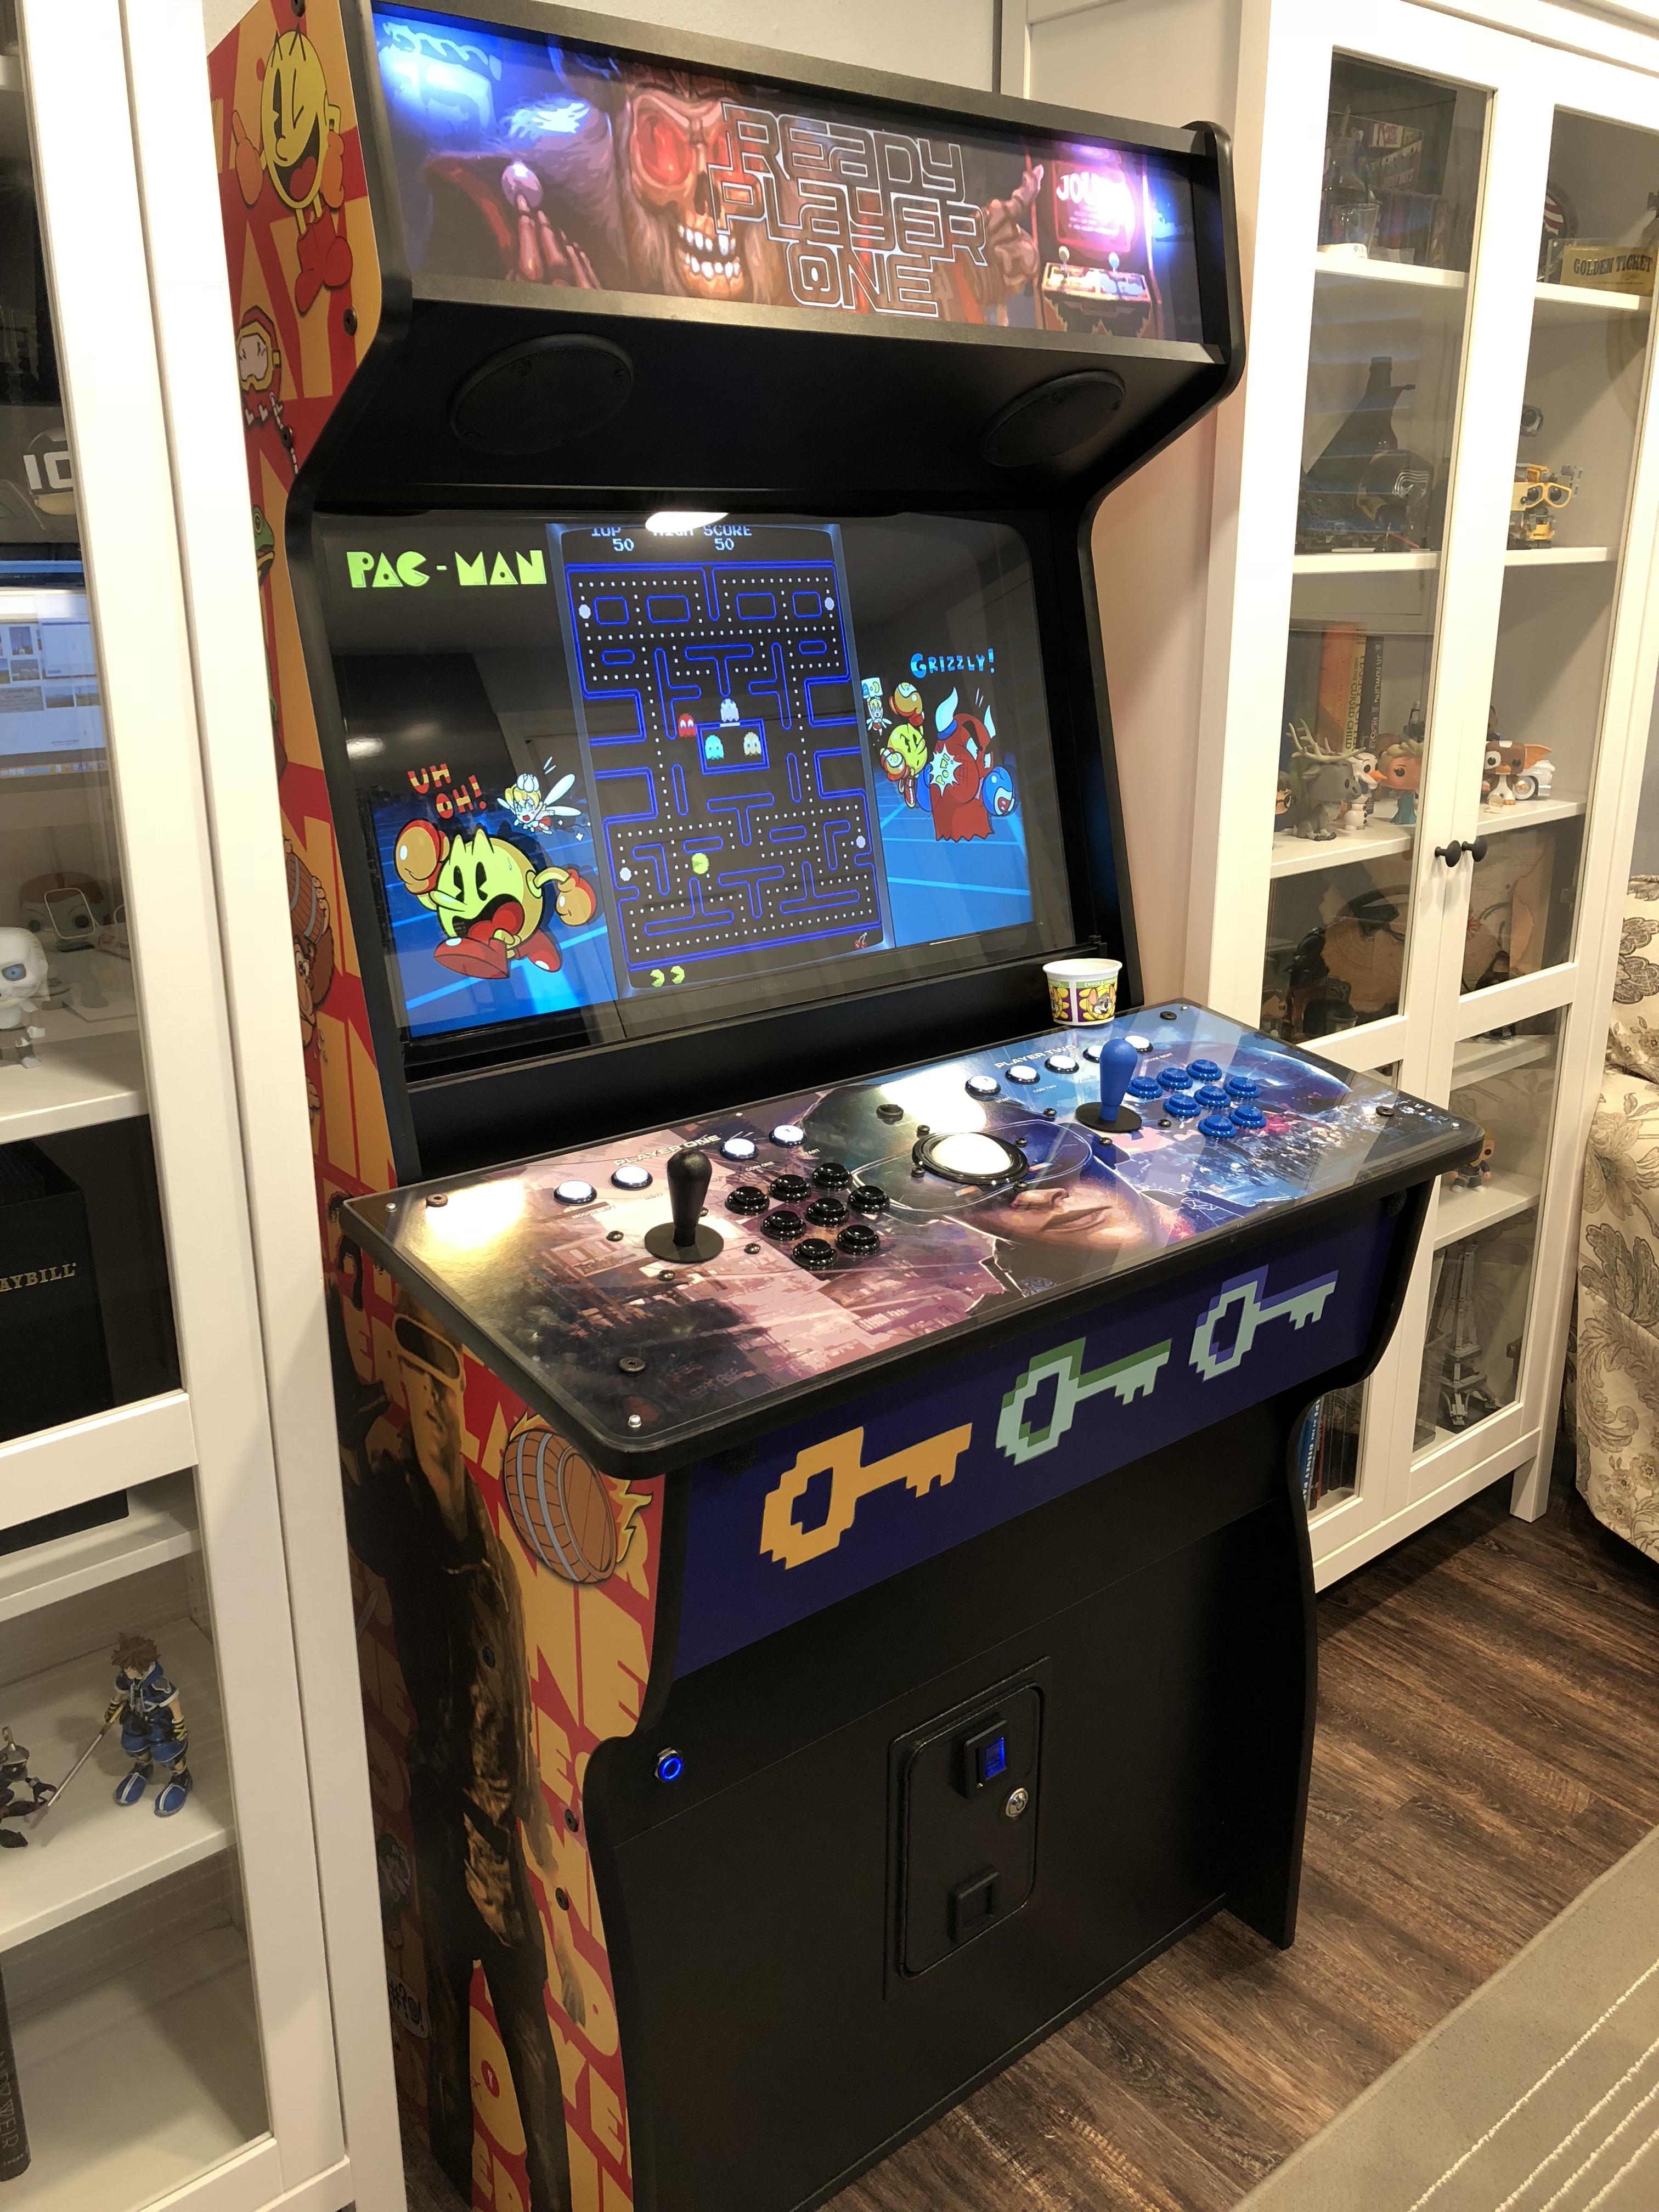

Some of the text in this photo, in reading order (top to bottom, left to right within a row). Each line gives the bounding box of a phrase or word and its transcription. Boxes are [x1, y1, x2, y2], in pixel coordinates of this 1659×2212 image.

[722, 101, 966, 203] READY
[707, 163, 988, 267] PLAYER
[786, 239, 939, 318] ONE
[1573, 253, 1653, 276] GOLDEN TICKET
[613, 538, 635, 551] 50
[703, 525, 752, 537] SCORE
[714, 537, 735, 550] 50
[910, 648, 995, 679] GRIZZLY!
[1348, 682, 1358, 719] CURSED
[1345, 720, 1355, 750] CHILD
[407, 763, 452, 794] UH
[935, 752, 955, 786] POW!
[435, 774, 488, 819] OH!
[994, 1044, 1077, 1069] PLAYER TWO
[1032, 1085, 1046, 1094] COIN
[613, 1134, 721, 1166] PLAYER ONE
[745, 1160, 775, 1172] COIN ONE
[571, 1207, 599, 1220] MOUSE
[1304, 1443, 1314, 1479] DISNEY
